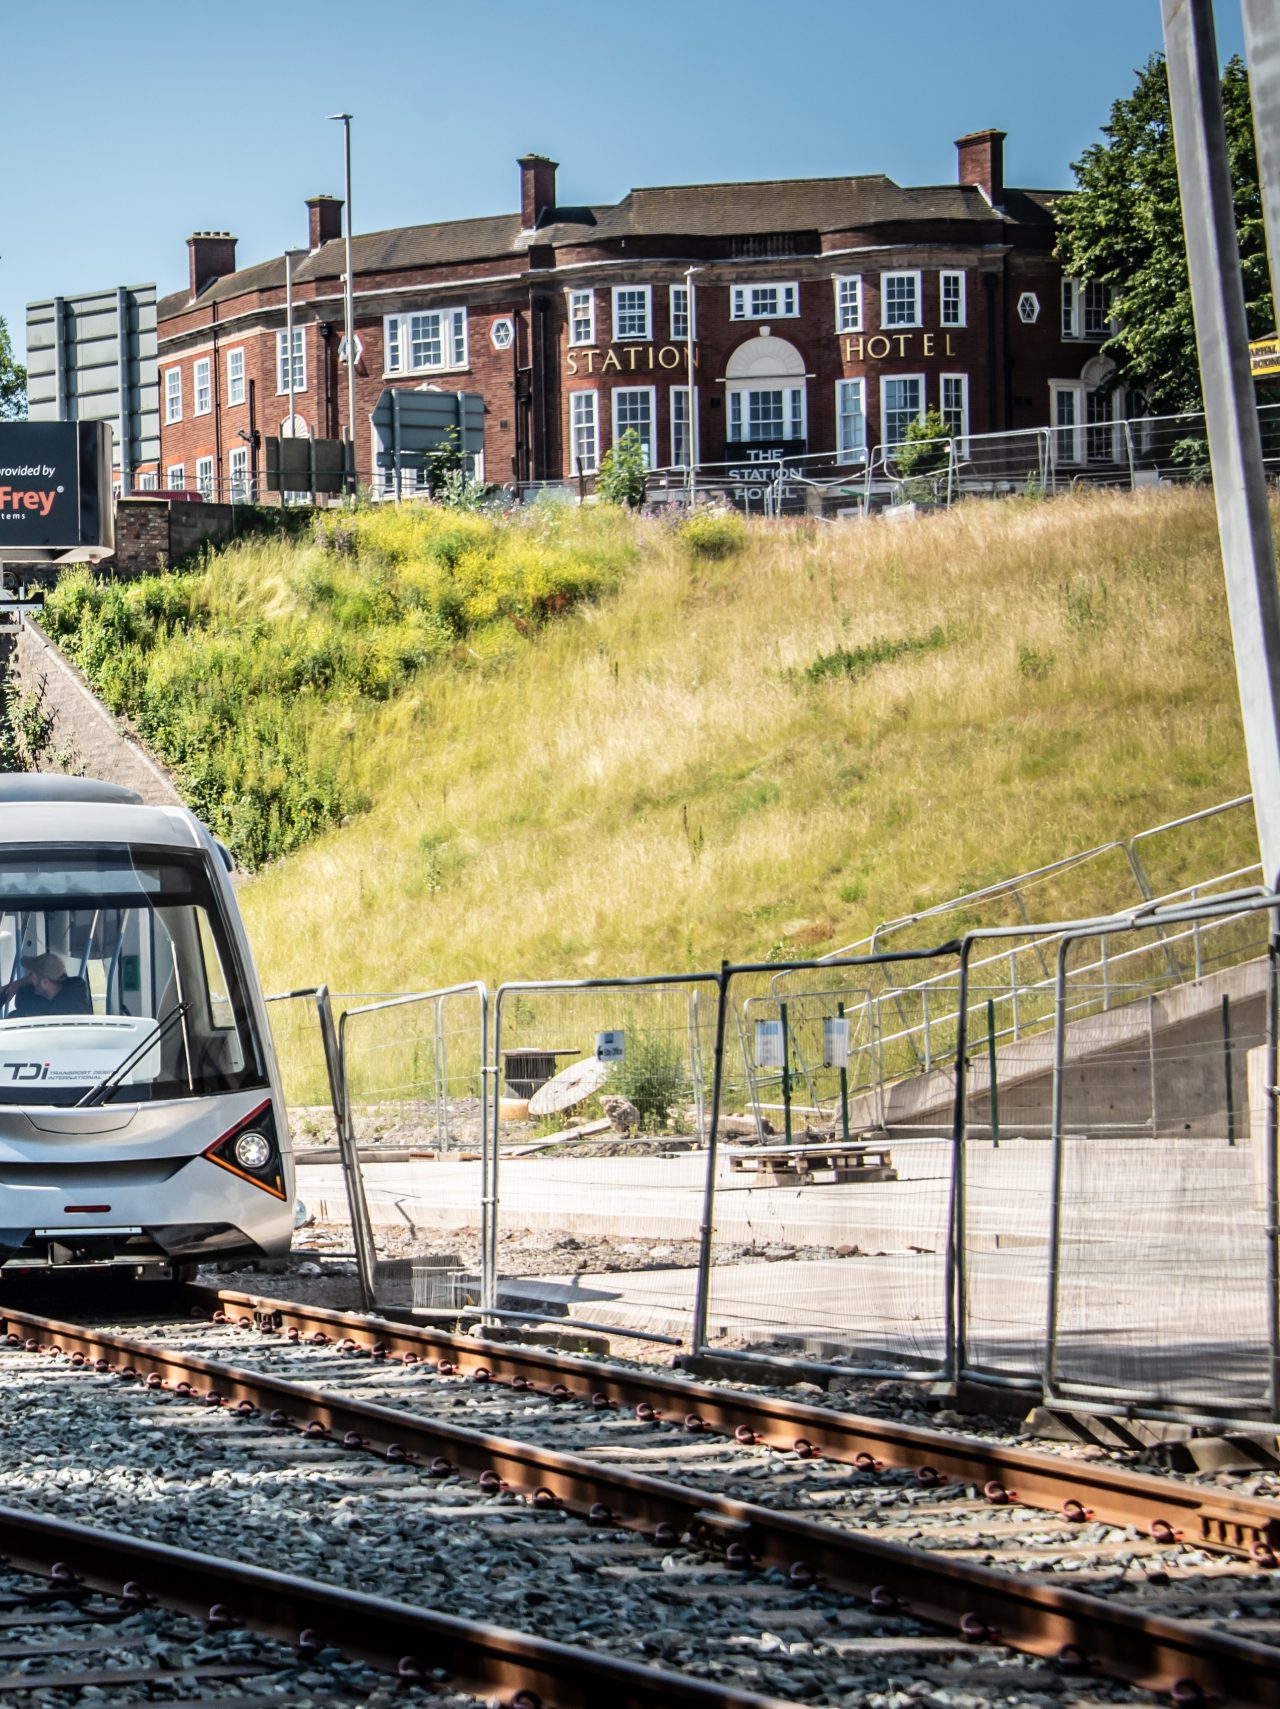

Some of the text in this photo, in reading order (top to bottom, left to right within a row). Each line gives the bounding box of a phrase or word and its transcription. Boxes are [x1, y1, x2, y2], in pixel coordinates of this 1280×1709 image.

[846, 333, 956, 361] HOTEL
[567, 346, 699, 375] STATION
[746, 449, 784, 461] THE
[42, 465, 56, 478] by
[728, 468, 803, 481] STATION
